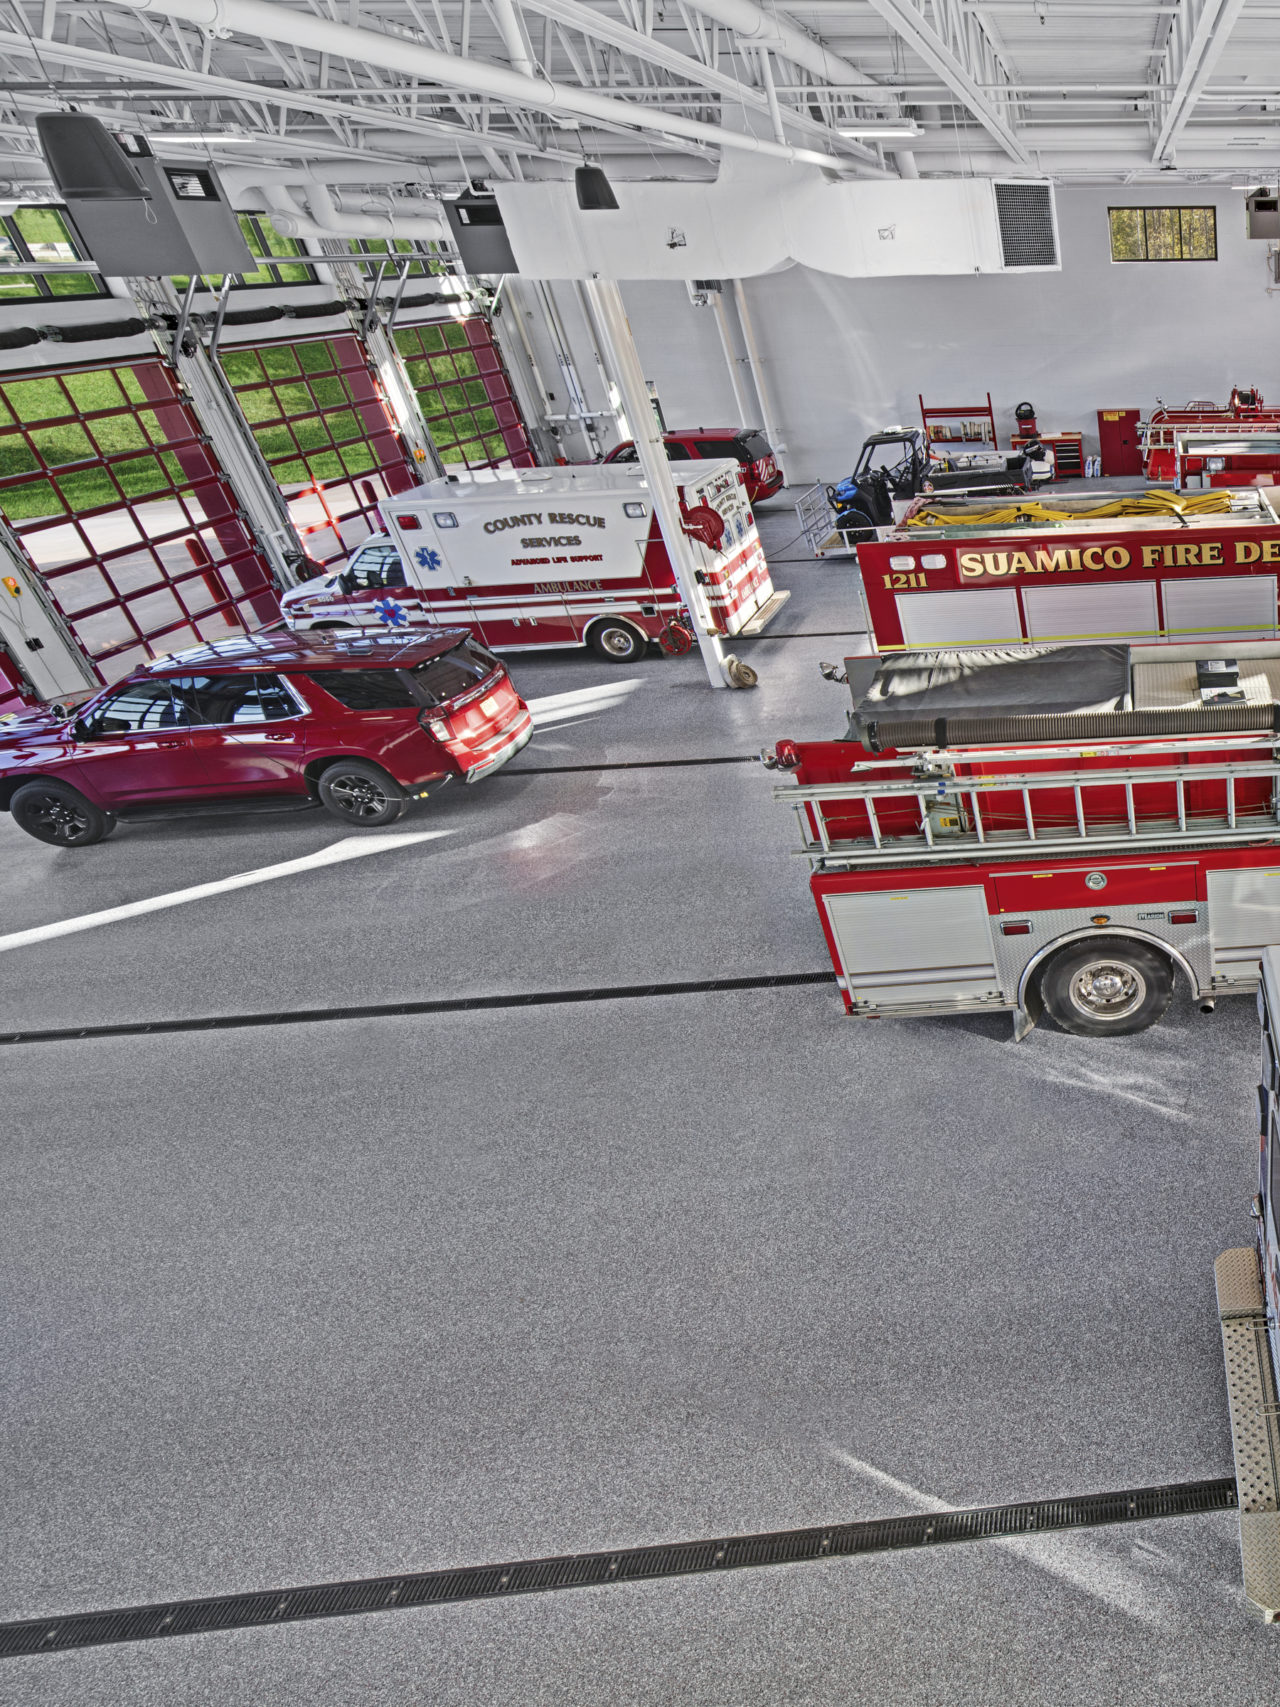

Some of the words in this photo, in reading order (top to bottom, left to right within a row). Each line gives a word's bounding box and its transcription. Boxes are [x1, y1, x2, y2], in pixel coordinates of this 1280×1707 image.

[483, 513, 543, 534] COUNTY
[547, 512, 606, 529] RESCUE
[520, 535, 582, 548] SERVICES
[511, 557, 550, 566] ADVANCED
[552, 556, 568, 564] LIFE
[570, 554, 604, 563] SUPPORT
[960, 546, 1132, 577] SUAMICO
[1141, 542, 1225, 568] FIRE
[534, 579, 604, 594] AMBULANCE
[881, 571, 929, 590] 1211
